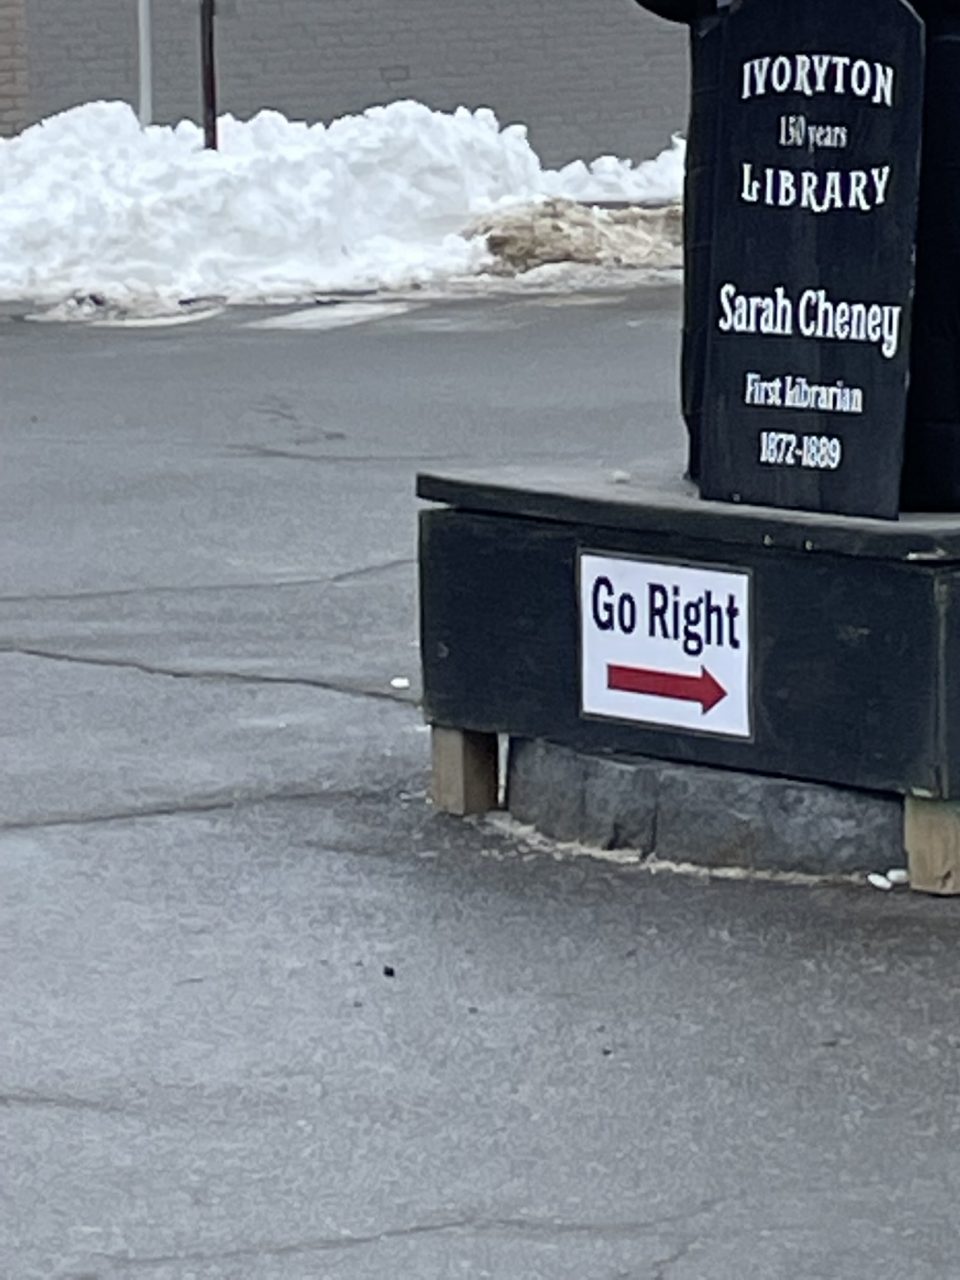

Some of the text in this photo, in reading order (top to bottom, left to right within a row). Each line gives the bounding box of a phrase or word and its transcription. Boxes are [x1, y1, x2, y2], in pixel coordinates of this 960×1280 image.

[741, 54, 894, 107] IVORYTON
[779, 115, 847, 153] 150 years
[741, 163, 890, 213] LIBRARY
[719, 283, 901, 359] Sarah Cheney
[745, 373, 863, 413] First Librarian
[760, 431, 841, 469] 1872-1889
[592, 575, 740, 656] Go Right
